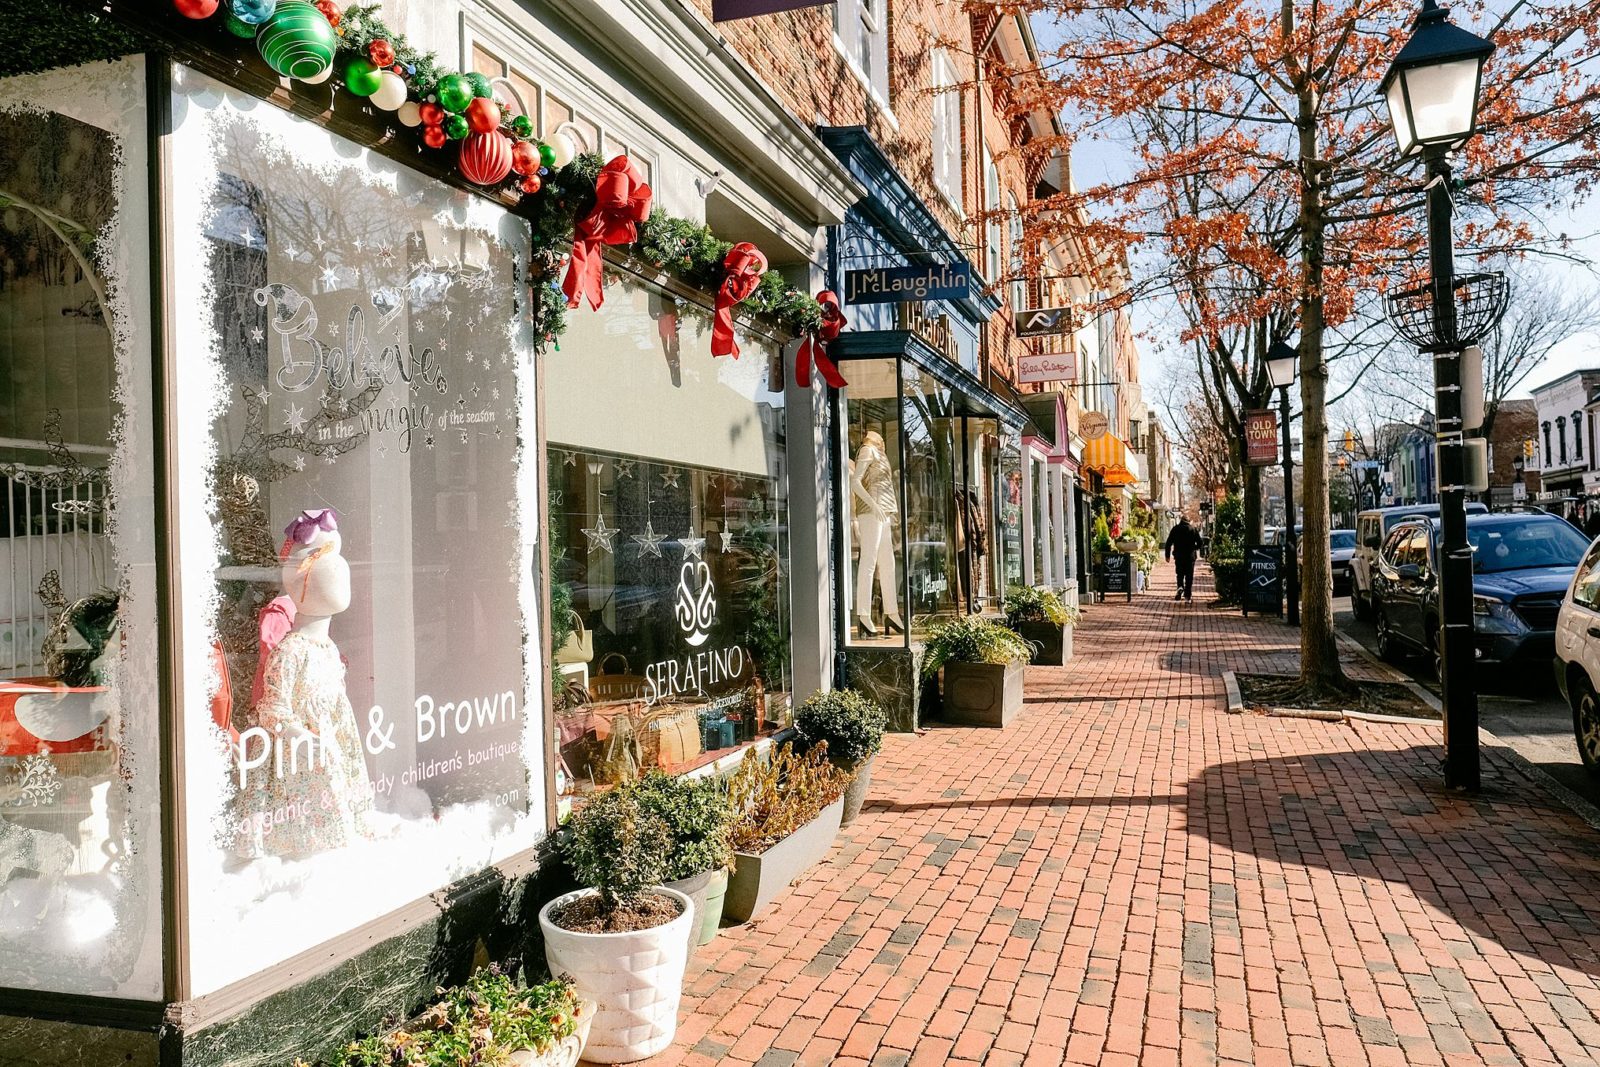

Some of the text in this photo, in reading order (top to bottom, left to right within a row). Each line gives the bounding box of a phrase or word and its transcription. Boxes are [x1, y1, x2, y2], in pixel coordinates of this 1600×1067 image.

[270, 300, 440, 392] Believe
[318, 403, 496, 454] in the magic of the season
[1248, 430, 1276, 440] TOWN
[1252, 420, 1272, 431] OLD
[1250, 562, 1277, 571] FITNESS
[644, 645, 743, 707] SERAFINO
[365, 704, 396, 755] &
[414, 689, 516, 743] Brown
[238, 798, 311, 836] organic
[320, 791, 333, 811] &
[401, 750, 464, 787] children's
[467, 740, 519, 766] boutique
